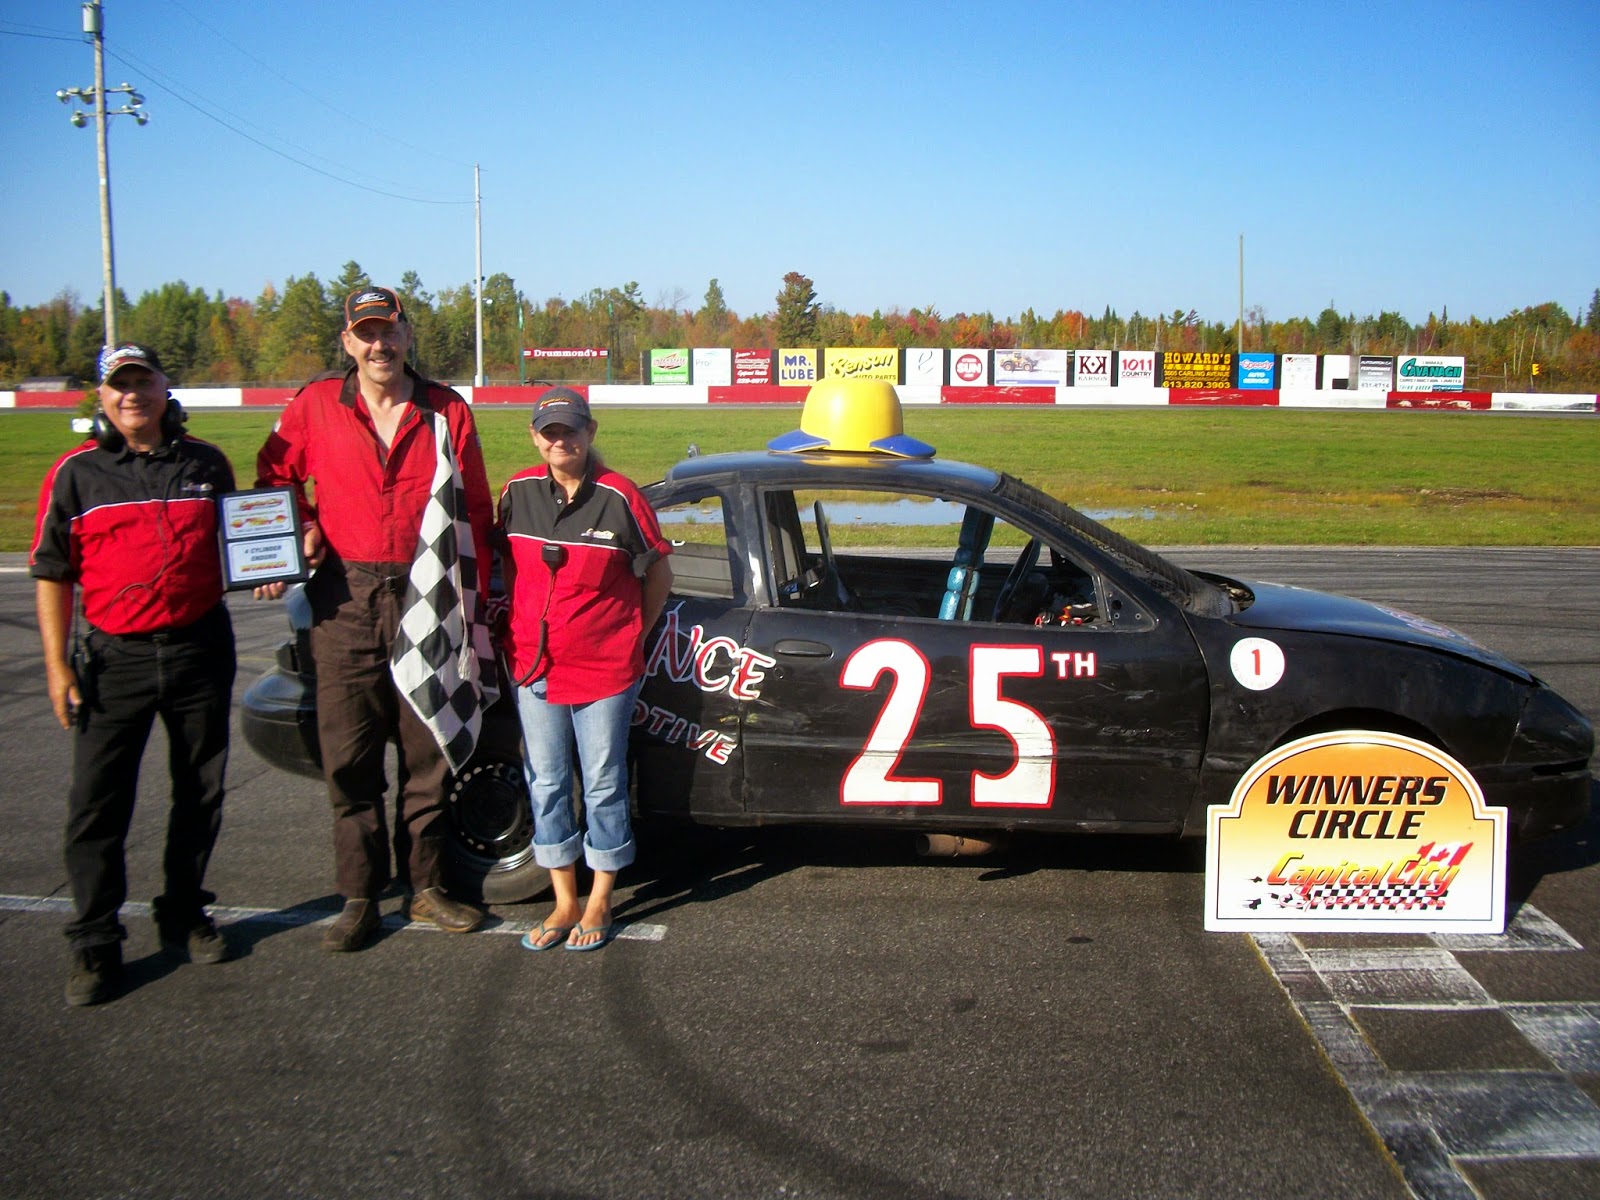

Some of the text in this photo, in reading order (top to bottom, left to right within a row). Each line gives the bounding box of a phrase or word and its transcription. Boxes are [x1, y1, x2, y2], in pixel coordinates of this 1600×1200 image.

[534, 349, 597, 357] Drummond's
[1164, 353, 1231, 365] HOWARD'S
[784, 355, 811, 366] MR.
[1240, 359, 1274, 371] Speedy
[957, 362, 981, 373] SUN
[1400, 357, 1462, 378] CAVANAGH
[781, 369, 814, 380] LUBE
[1251, 648, 1261, 676] 1
[1266, 775, 1450, 806] WINNERS
[1287, 809, 1426, 840] CIRCLE
[1266, 851, 1461, 897] Capital City
